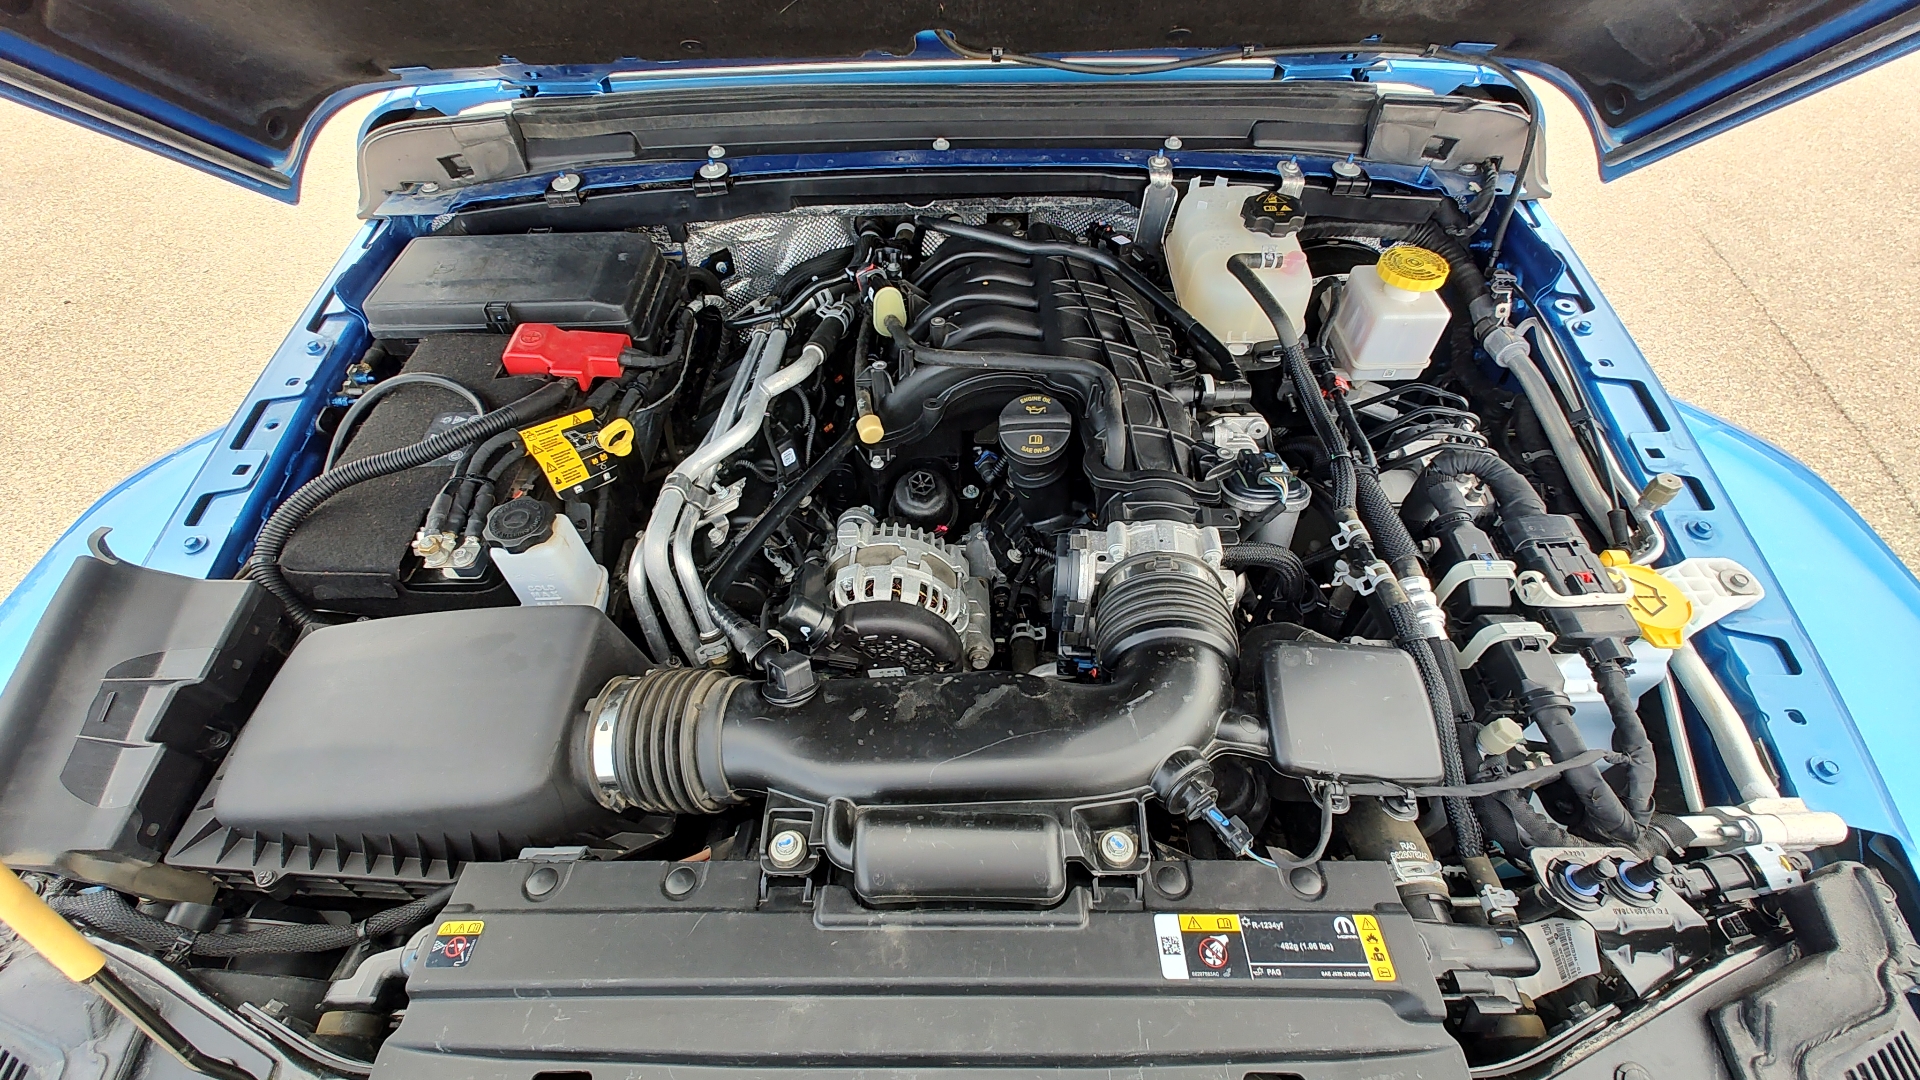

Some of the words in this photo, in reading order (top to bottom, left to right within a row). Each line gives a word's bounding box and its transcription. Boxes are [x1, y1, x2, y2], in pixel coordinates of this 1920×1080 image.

[1020, 396, 1041, 404] ENGINE
[1021, 445, 1033, 454] SAE
[1399, 842, 1417, 850] RAD
[1252, 921, 1284, 931] R-1234yf
[1319, 942, 1335, 952] lbs)
[1267, 968, 1282, 977] PAG
